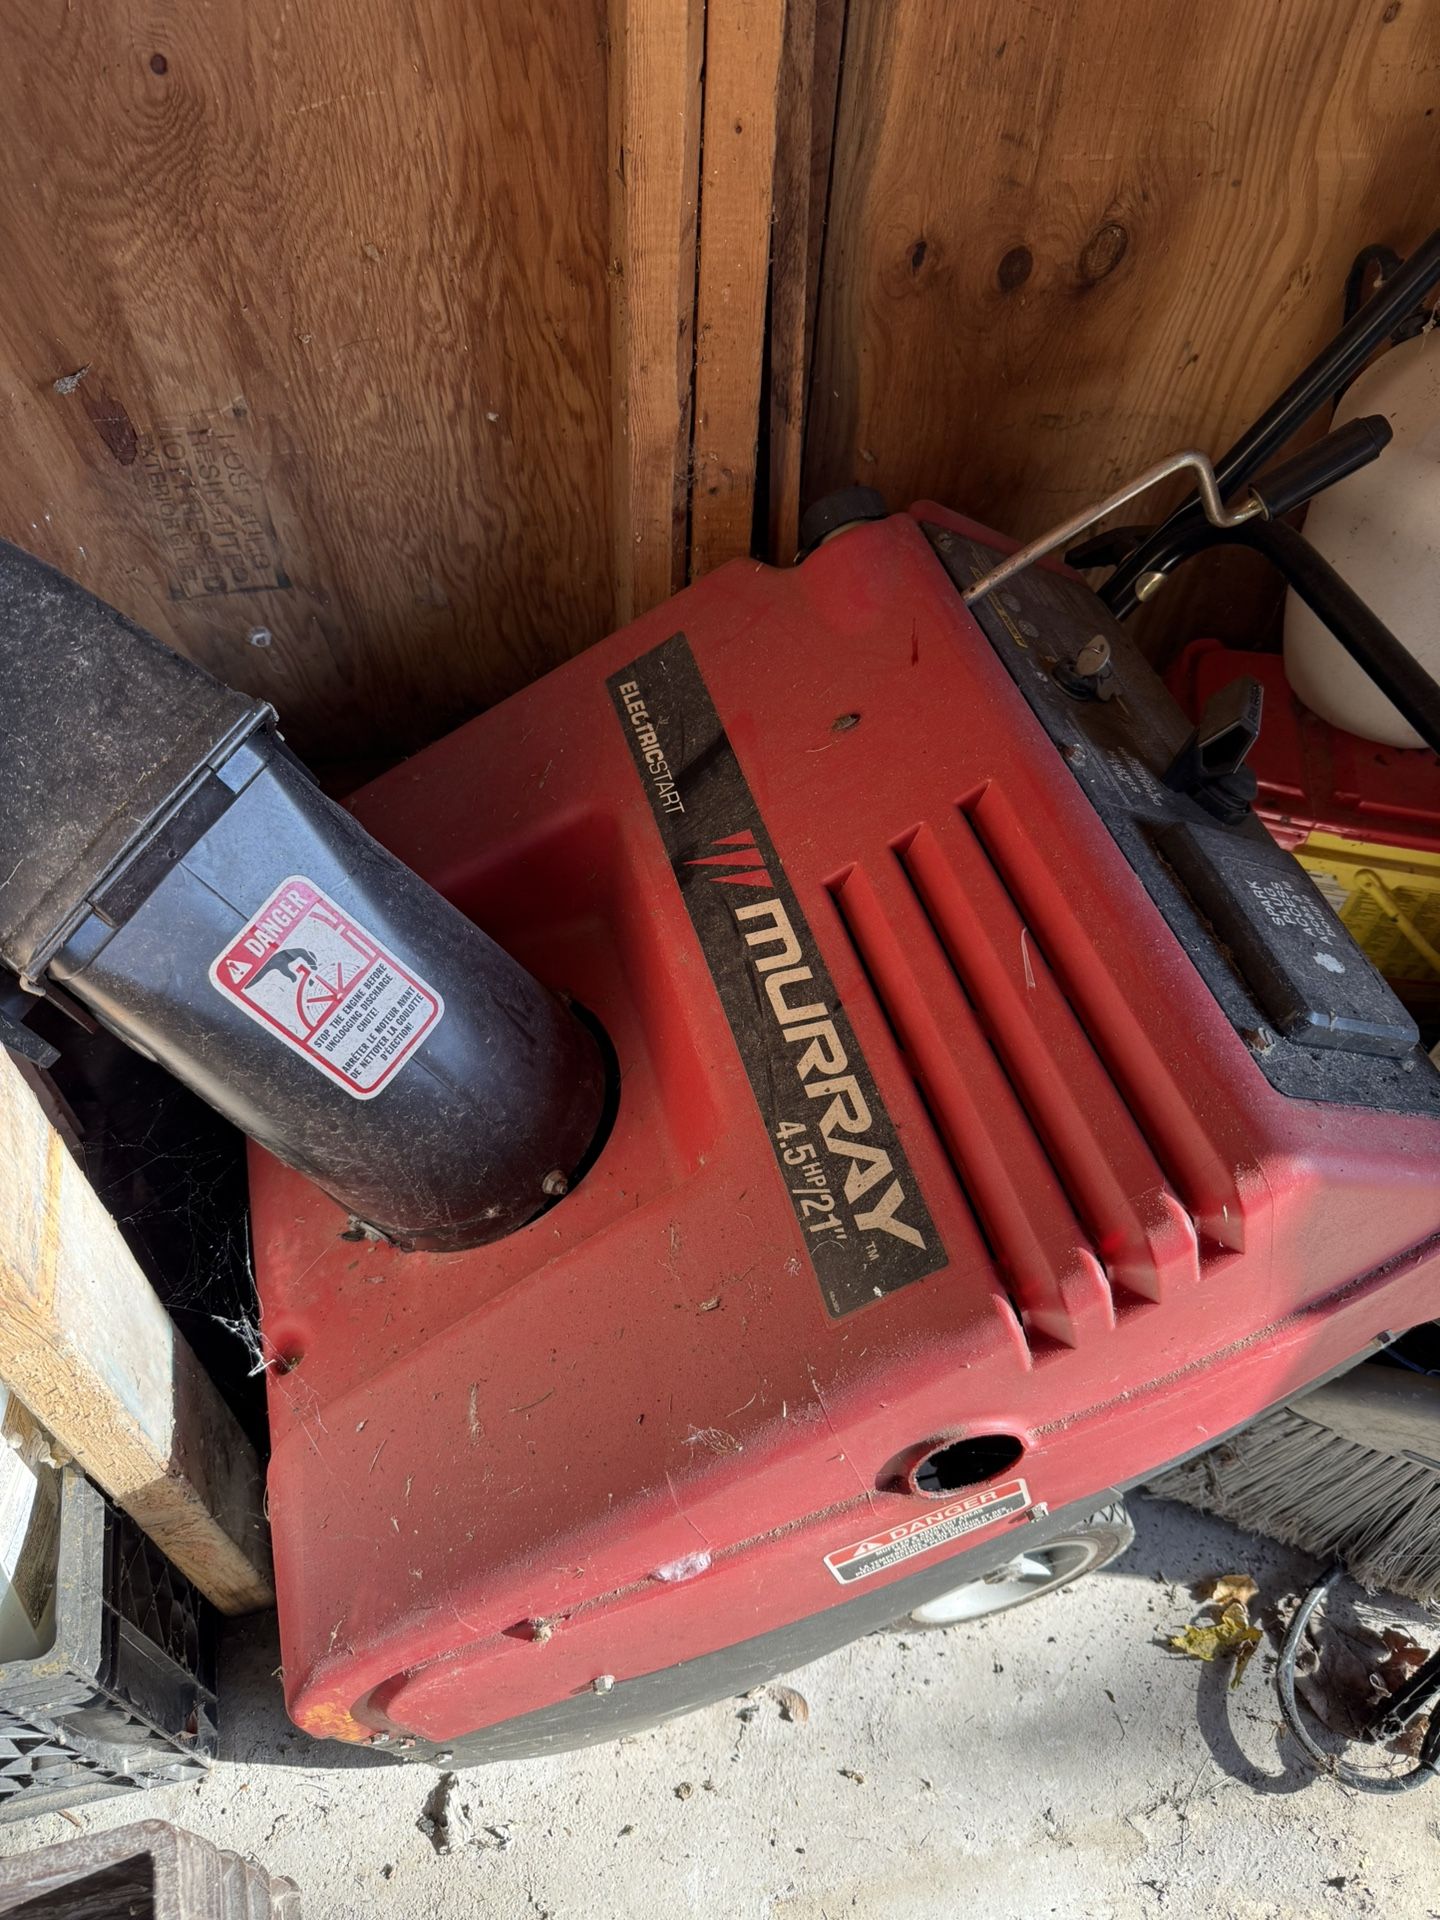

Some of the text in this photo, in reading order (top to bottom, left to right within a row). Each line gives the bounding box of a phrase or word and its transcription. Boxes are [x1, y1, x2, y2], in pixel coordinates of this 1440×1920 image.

[244, 889, 310, 958] DANGER
[1245, 880, 1285, 926] SPARK
[1263, 887, 1297, 925] PLUG
[1270, 881, 1317, 937] ACCESS
[314, 963, 387, 1048] STOP THE ENGINE BEFORE
[326, 974, 394, 1052] UNCLOGGING DISCHARGE
[342, 985, 416, 1073] ARRÊTER LE MOTEUR AVANT
[356, 1008, 380, 1033] CHUTE!
[350, 1067, 362, 1079] DE
[360, 1035, 390, 1069] NETTOYER
[386, 1024, 398, 1039] LA
[735, 898, 926, 1251] MURRAY
[889, 1491, 997, 1540] DANGER
